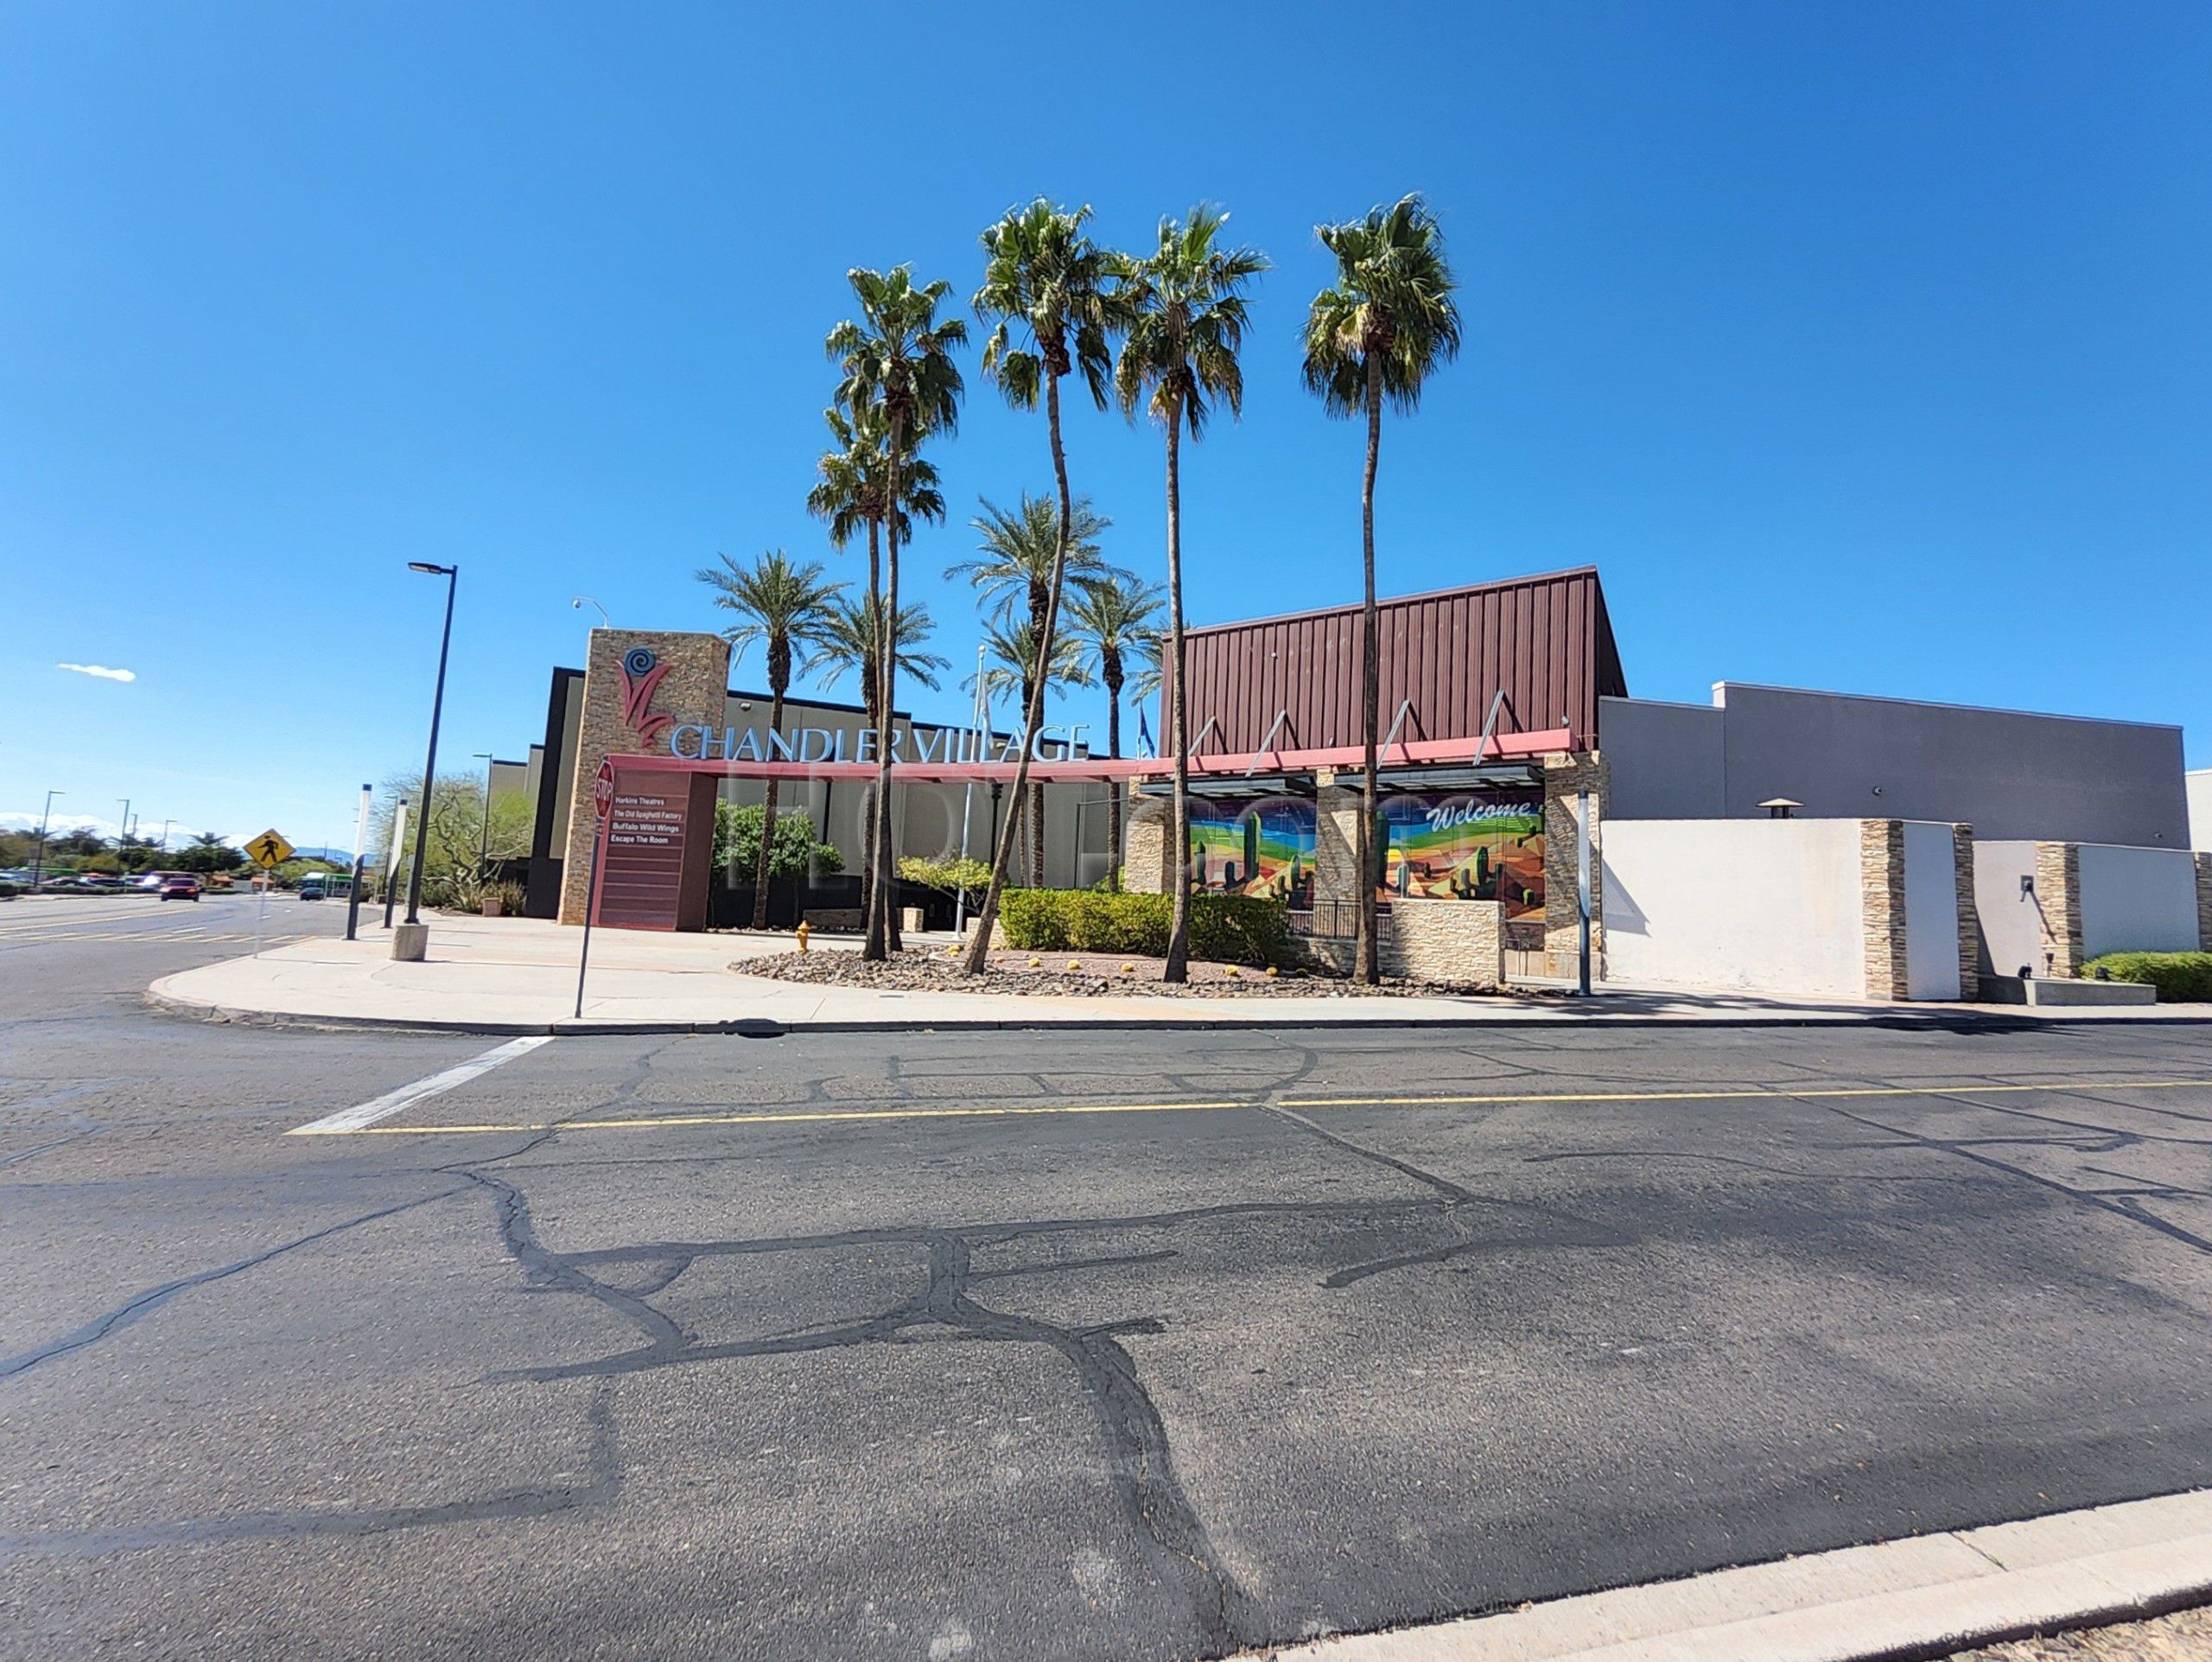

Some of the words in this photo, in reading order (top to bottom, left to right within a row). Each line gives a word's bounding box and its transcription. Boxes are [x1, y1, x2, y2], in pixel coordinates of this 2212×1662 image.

[670, 724, 903, 764] CHANDLER
[912, 724, 1090, 764] VILLAGE
[596, 778, 613, 801] STOP
[639, 797, 664, 806] Theatres
[662, 812, 683, 821] Factory
[1426, 798, 1531, 832] Welcome
[612, 822, 639, 831] Buffalo
[657, 825, 679, 833] Wings
[610, 834, 635, 844] Escape
[636, 835, 648, 844] The
